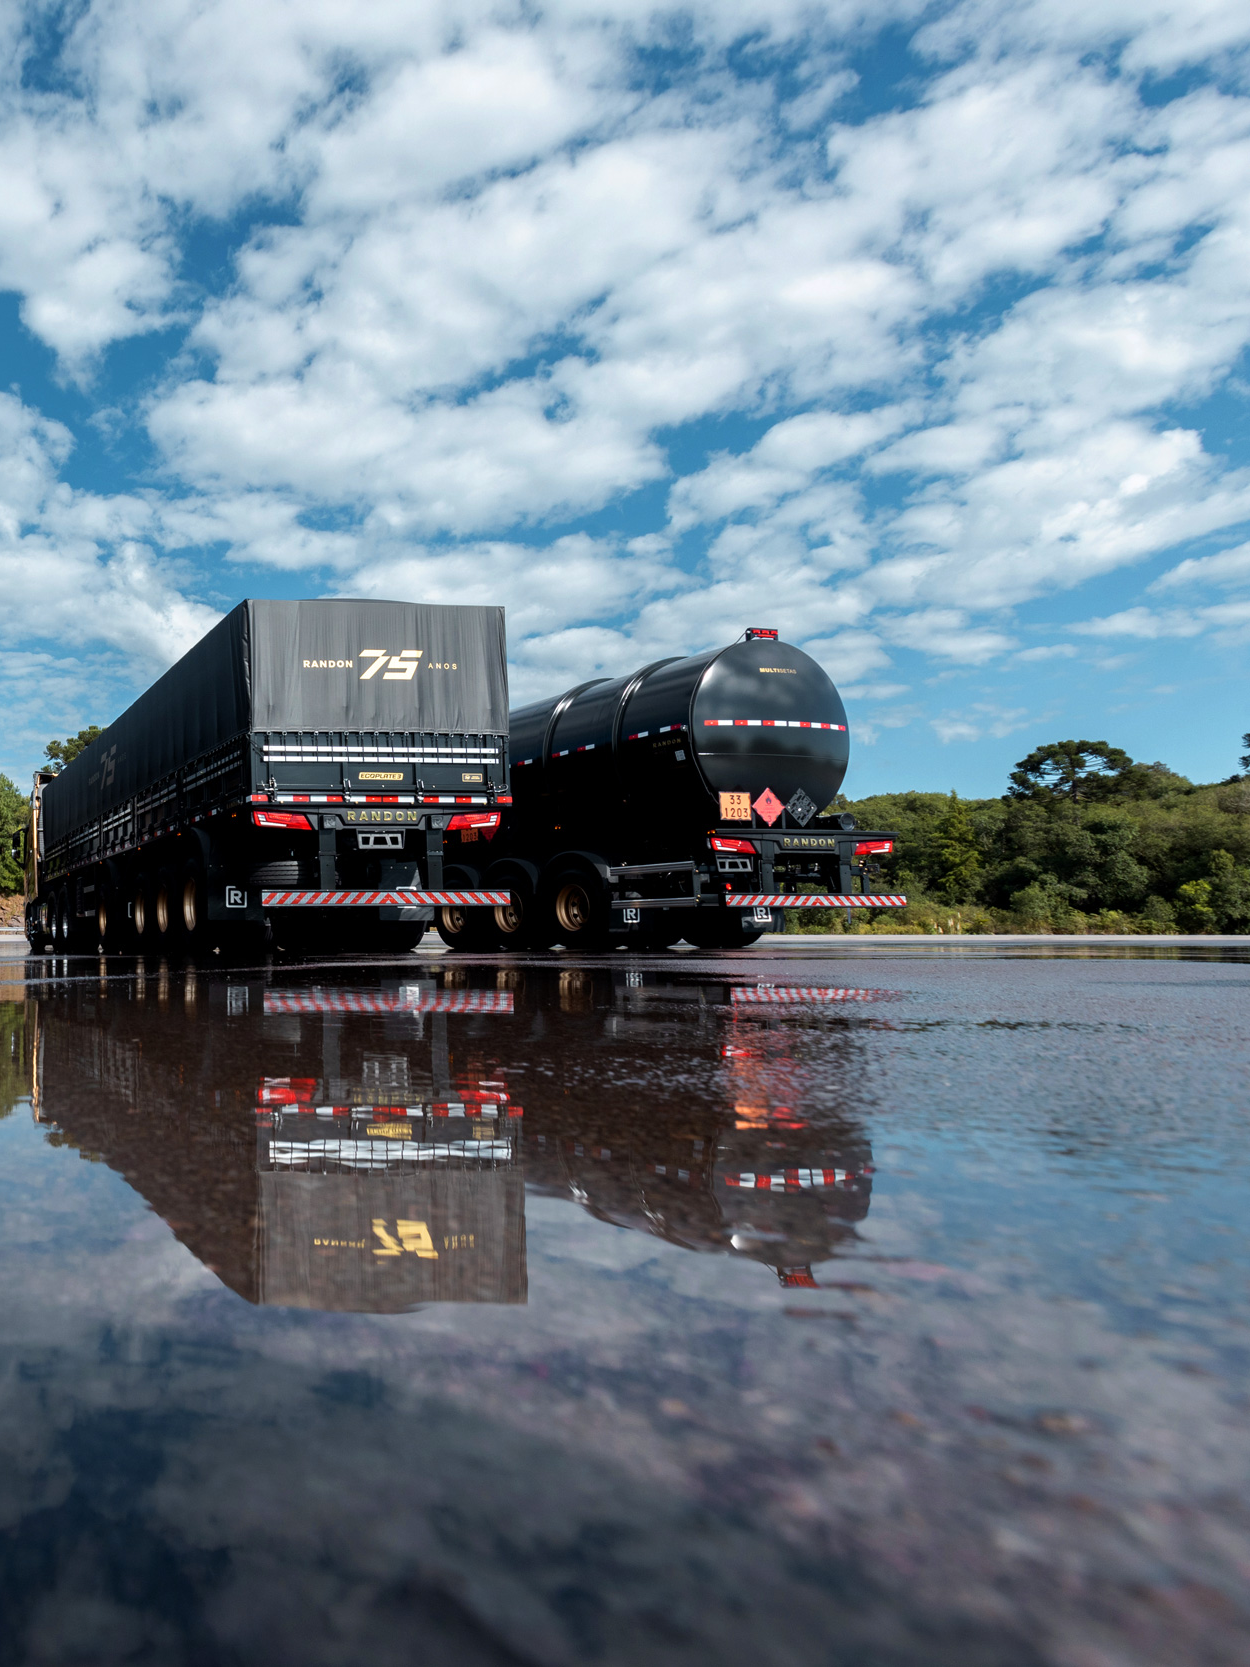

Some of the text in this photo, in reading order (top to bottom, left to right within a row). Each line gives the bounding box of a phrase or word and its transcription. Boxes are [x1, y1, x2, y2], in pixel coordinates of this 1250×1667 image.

[303, 649, 457, 680] RANDON 75 ANOS
[730, 795, 742, 804] 33
[347, 811, 417, 822] RANDON
[724, 808, 748, 818] 1203
[783, 838, 836, 848] RANDON
